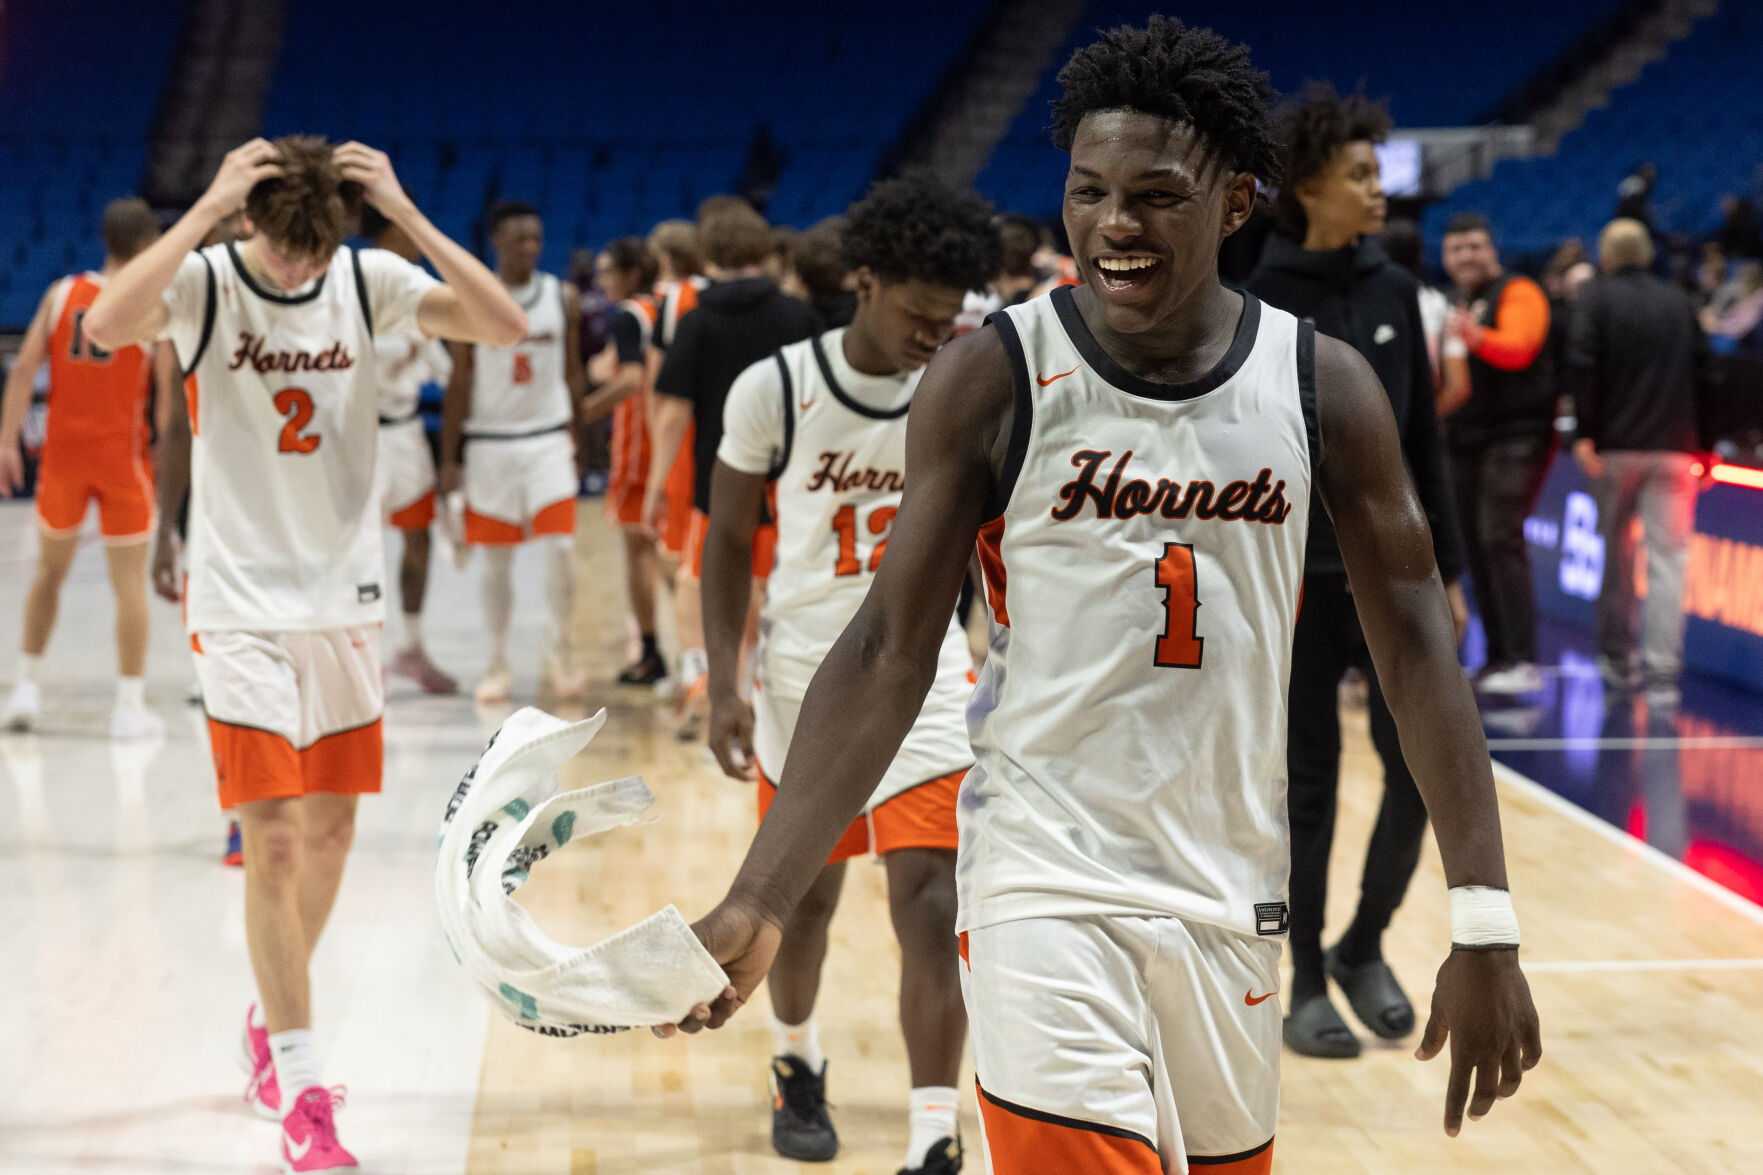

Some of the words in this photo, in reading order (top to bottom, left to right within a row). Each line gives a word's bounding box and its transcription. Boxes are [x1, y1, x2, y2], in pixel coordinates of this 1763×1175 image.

[71, 308, 111, 361] 1
[228, 330, 355, 374] Hornets
[272, 386, 322, 454] 2
[807, 450, 905, 493] Horn
[1051, 449, 1292, 525] Hornets
[1153, 541, 1205, 670] 1
